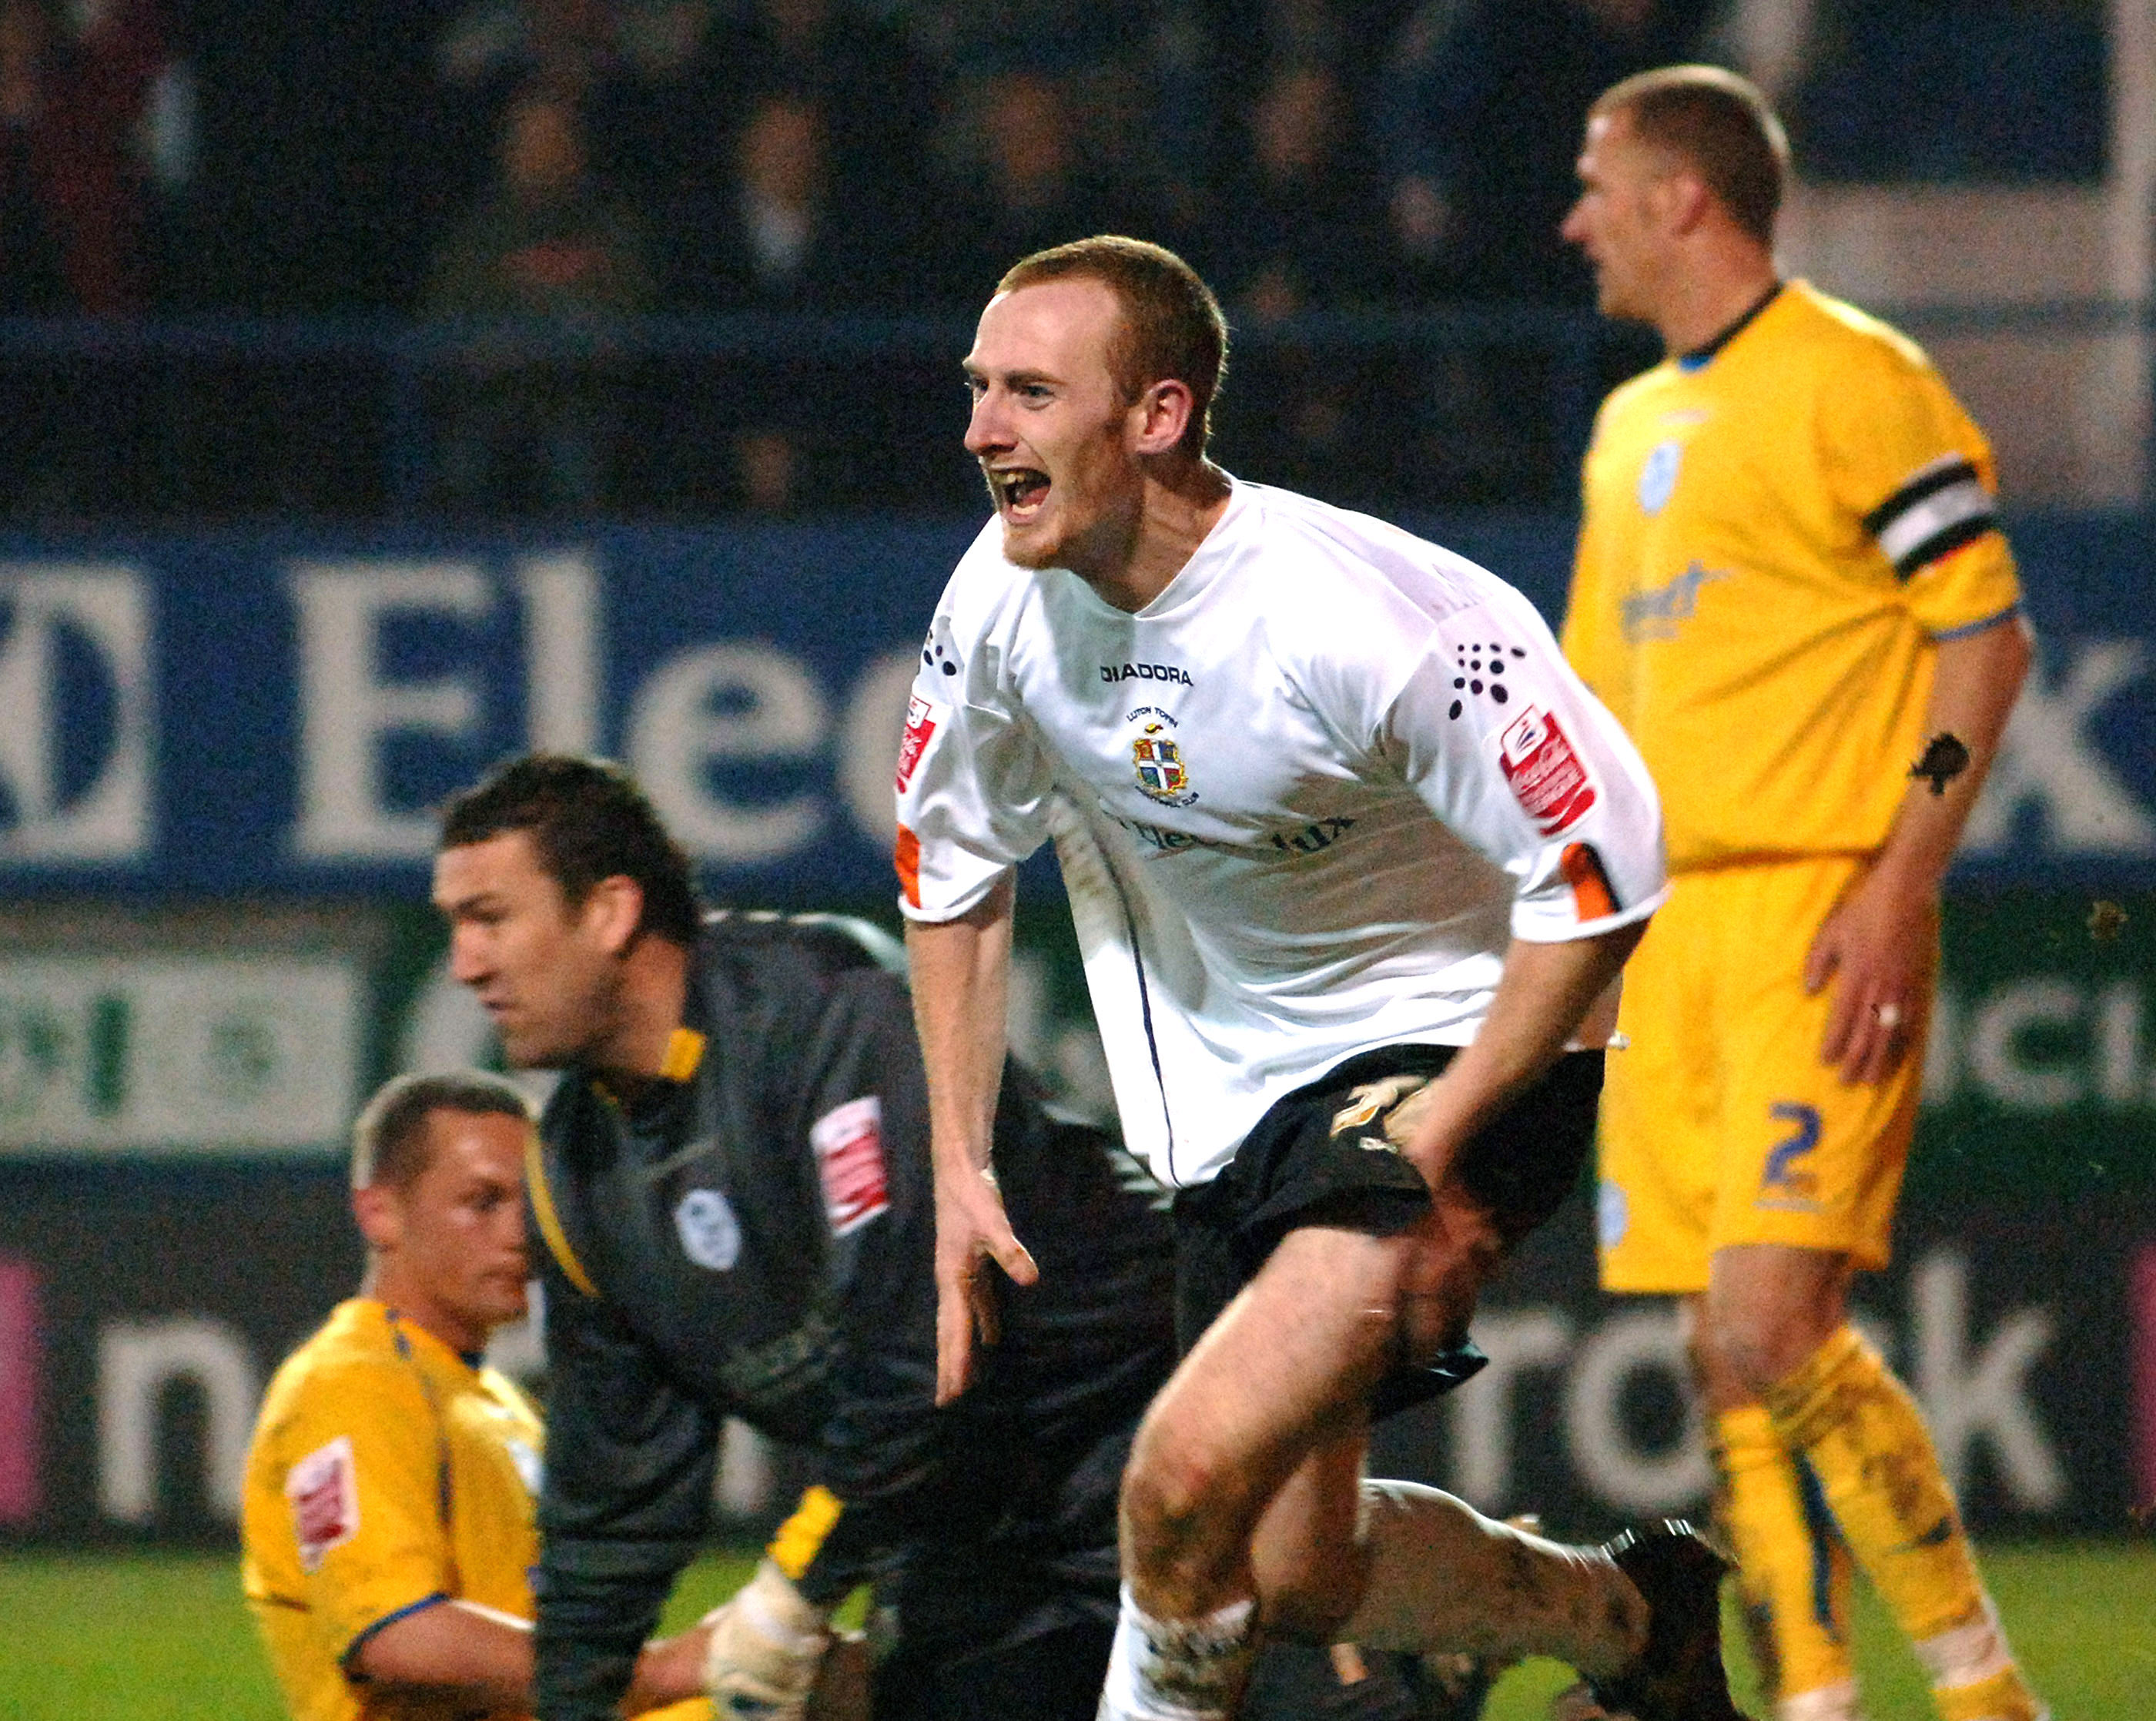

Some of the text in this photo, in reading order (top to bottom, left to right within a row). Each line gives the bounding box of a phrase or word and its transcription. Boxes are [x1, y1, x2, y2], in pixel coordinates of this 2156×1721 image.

[1100, 663, 1194, 687] DIADORA
[1762, 1100, 1823, 1194] 2
[1449, 1244, 2071, 1522] rok
